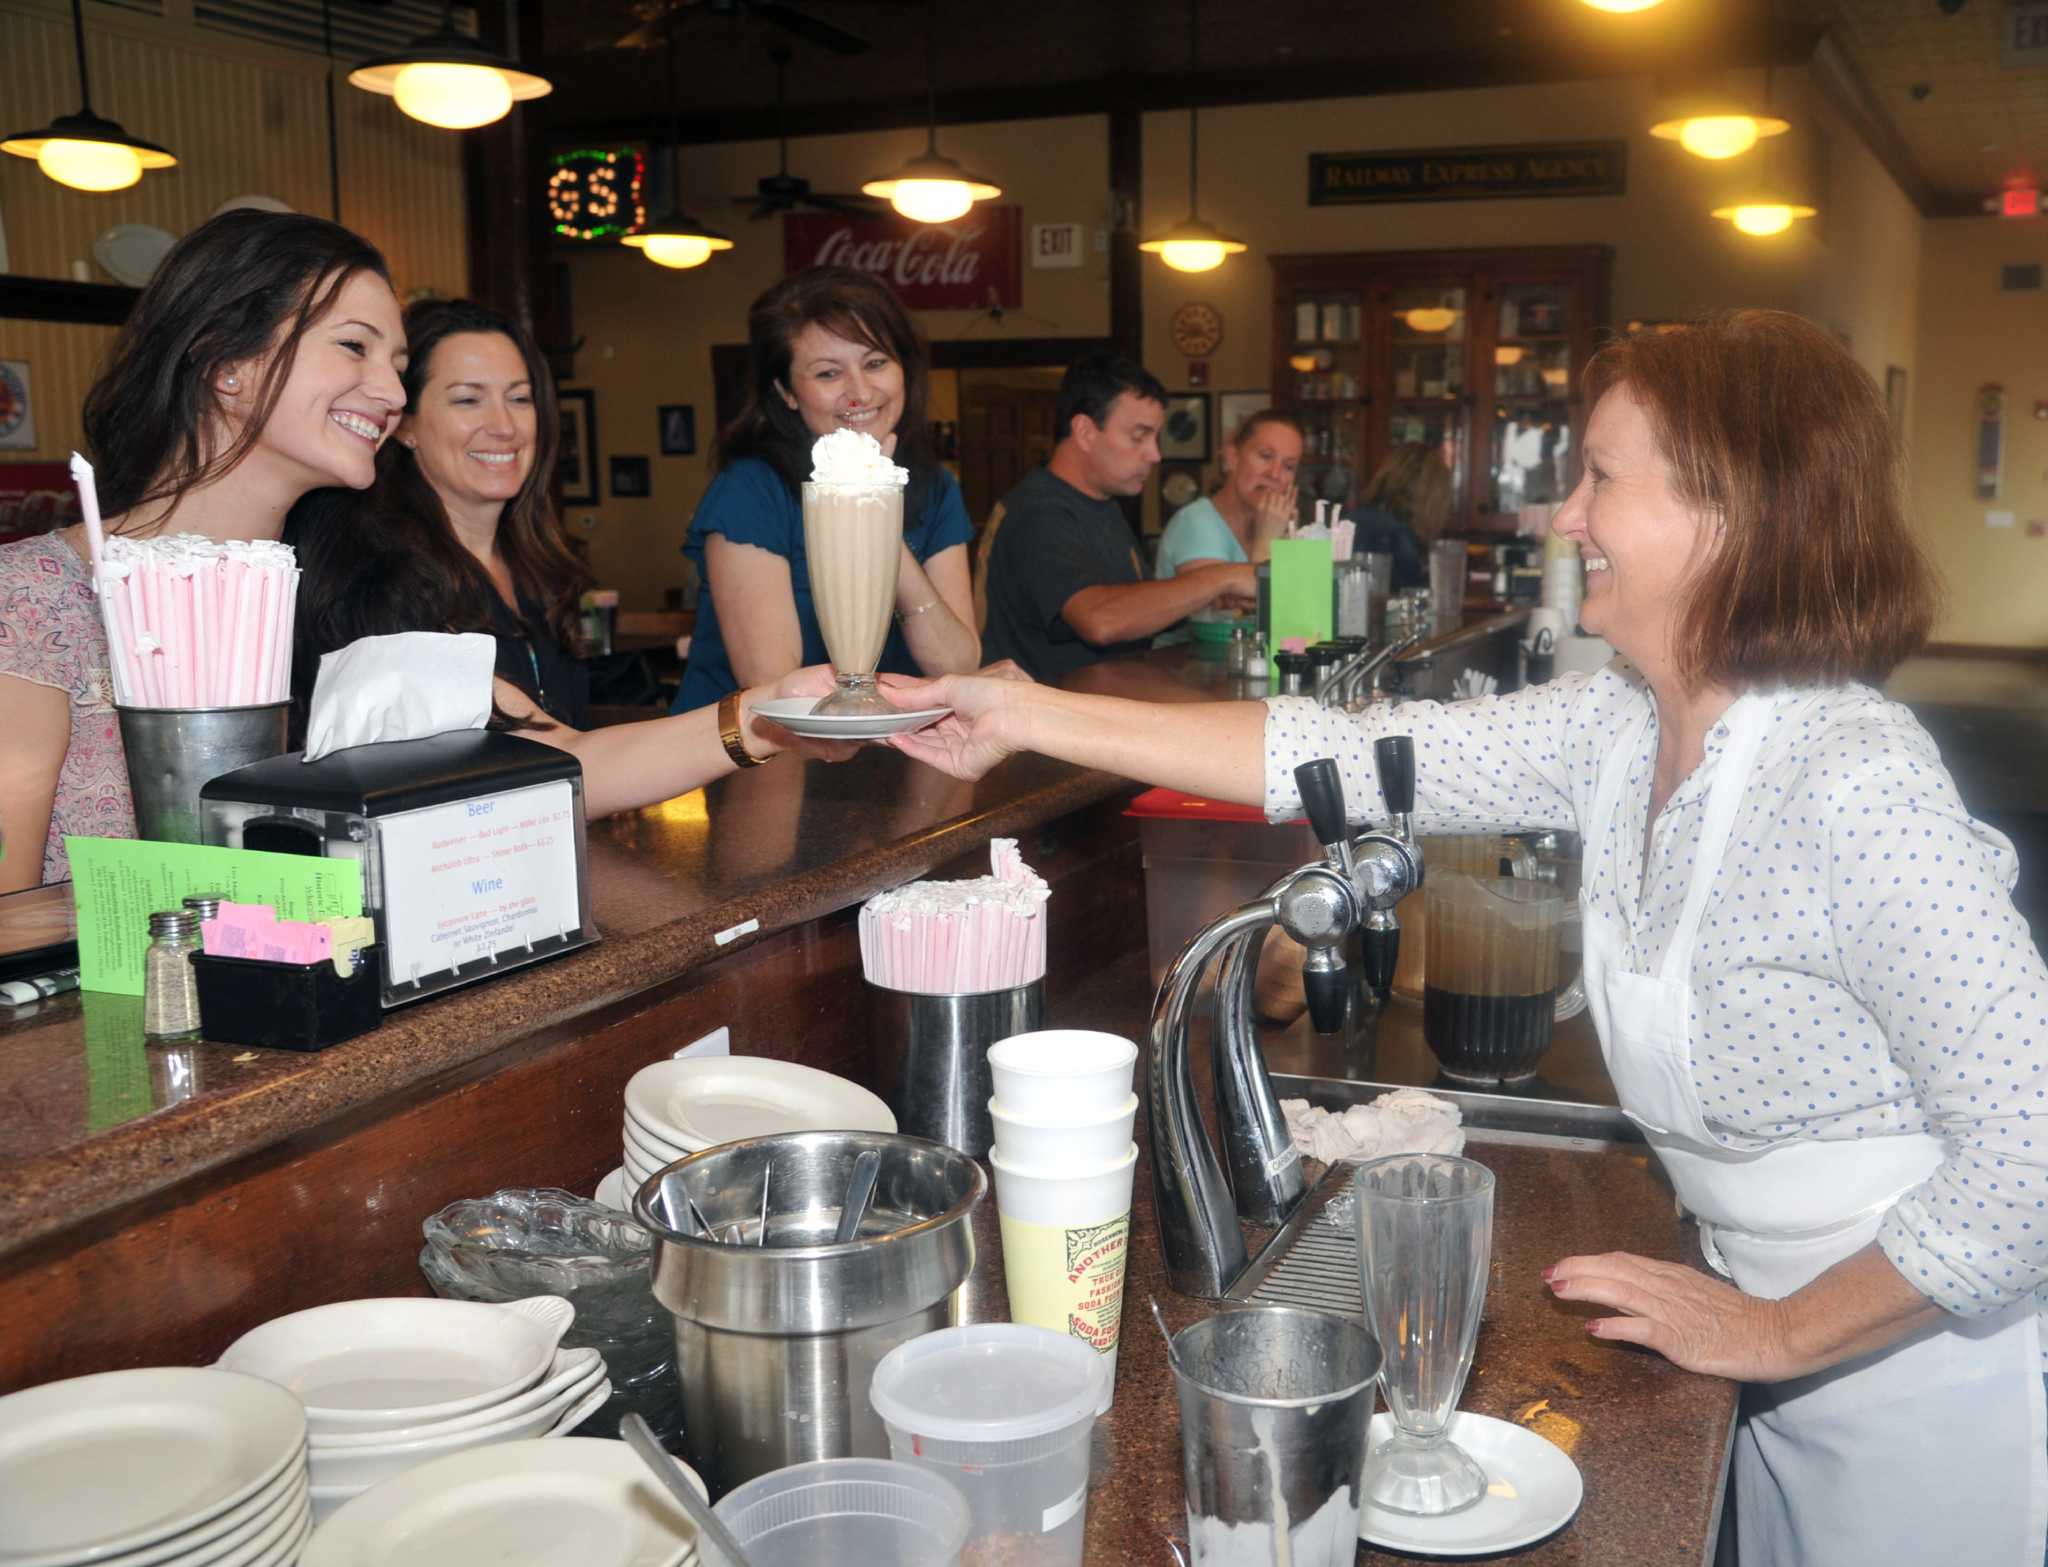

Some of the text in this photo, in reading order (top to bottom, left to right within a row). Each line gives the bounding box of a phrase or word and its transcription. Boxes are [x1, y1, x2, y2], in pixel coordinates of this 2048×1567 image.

[1040, 226, 1073, 256] EXIT
[467, 800, 495, 817] Beer
[472, 877, 503, 895] Wine
[1068, 1236, 1123, 1284] ANOTHER
[1092, 1272, 1114, 1286] TRUE
[1077, 1298, 1102, 1311] SODA
[1071, 1316, 1099, 1337] SODA
